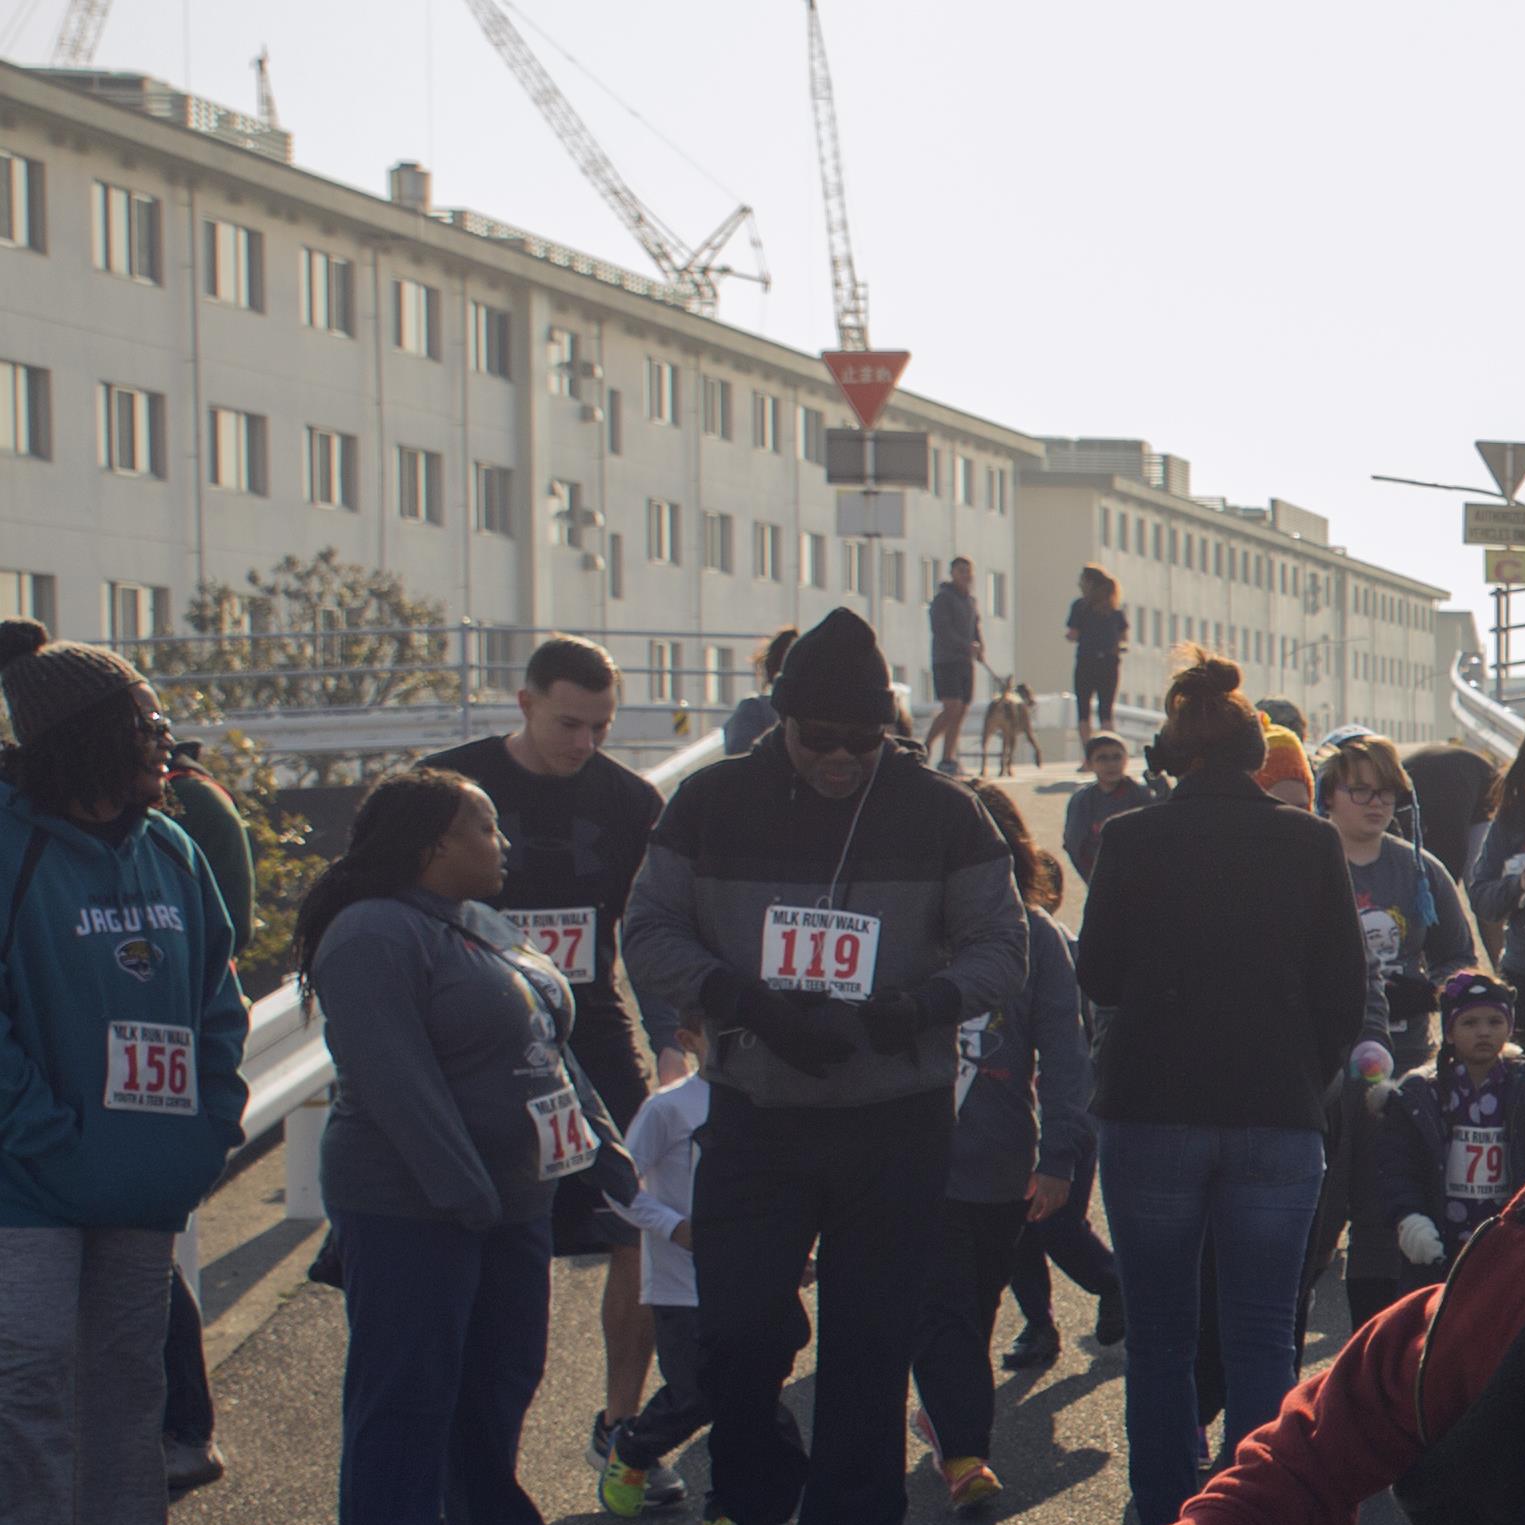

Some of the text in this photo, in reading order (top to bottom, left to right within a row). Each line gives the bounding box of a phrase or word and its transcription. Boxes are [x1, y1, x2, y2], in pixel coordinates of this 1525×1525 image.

[842, 365, 893, 384] 止まれ
[533, 912, 588, 927] RUN/WALK
[772, 911, 870, 933] MLK RUN/WALK
[523, 928, 583, 970] 27
[778, 929, 860, 979] 119
[805, 979, 826, 992] TEEN
[114, 1024, 191, 1046] MLK RUN/WALK
[124, 1043, 187, 1094] 156
[549, 1109, 593, 1160] 14
[1466, 1144, 1503, 1184] 79
